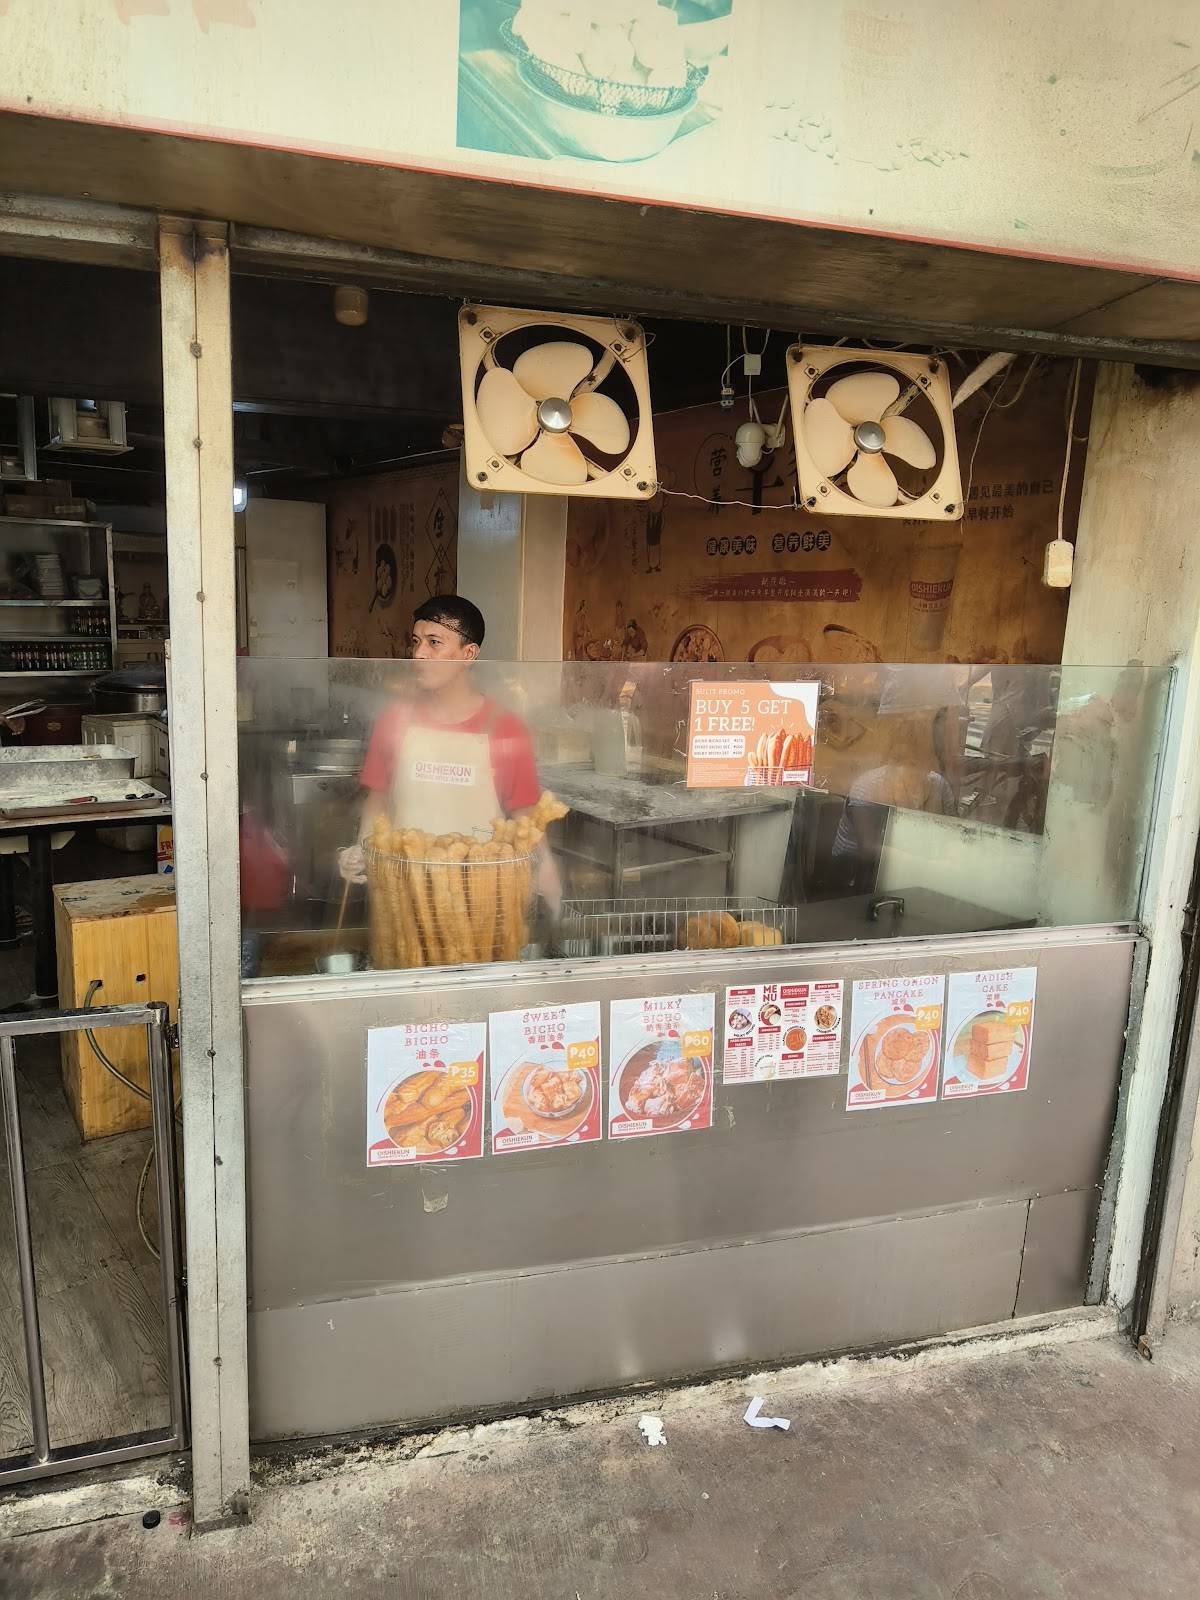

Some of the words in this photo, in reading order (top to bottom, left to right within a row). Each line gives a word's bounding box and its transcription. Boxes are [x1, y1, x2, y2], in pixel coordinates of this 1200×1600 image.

[718, 687, 746, 696] PROMO
[695, 700, 732, 715] BUY
[740, 700, 750, 714] 5
[757, 699, 793, 714] GET
[694, 717, 703, 732] 1
[708, 715, 756, 732] FREE!
[763, 985, 778, 994] ME
[982, 983, 1009, 993] CAKE
[762, 993, 777, 1002] NU
[873, 989, 924, 1000] PANCAKE
[642, 1012, 682, 1024] BICHO
[403, 1023, 450, 1034] BICHO
[523, 1022, 566, 1036] BICHO
[403, 1035, 449, 1047] BICHO
